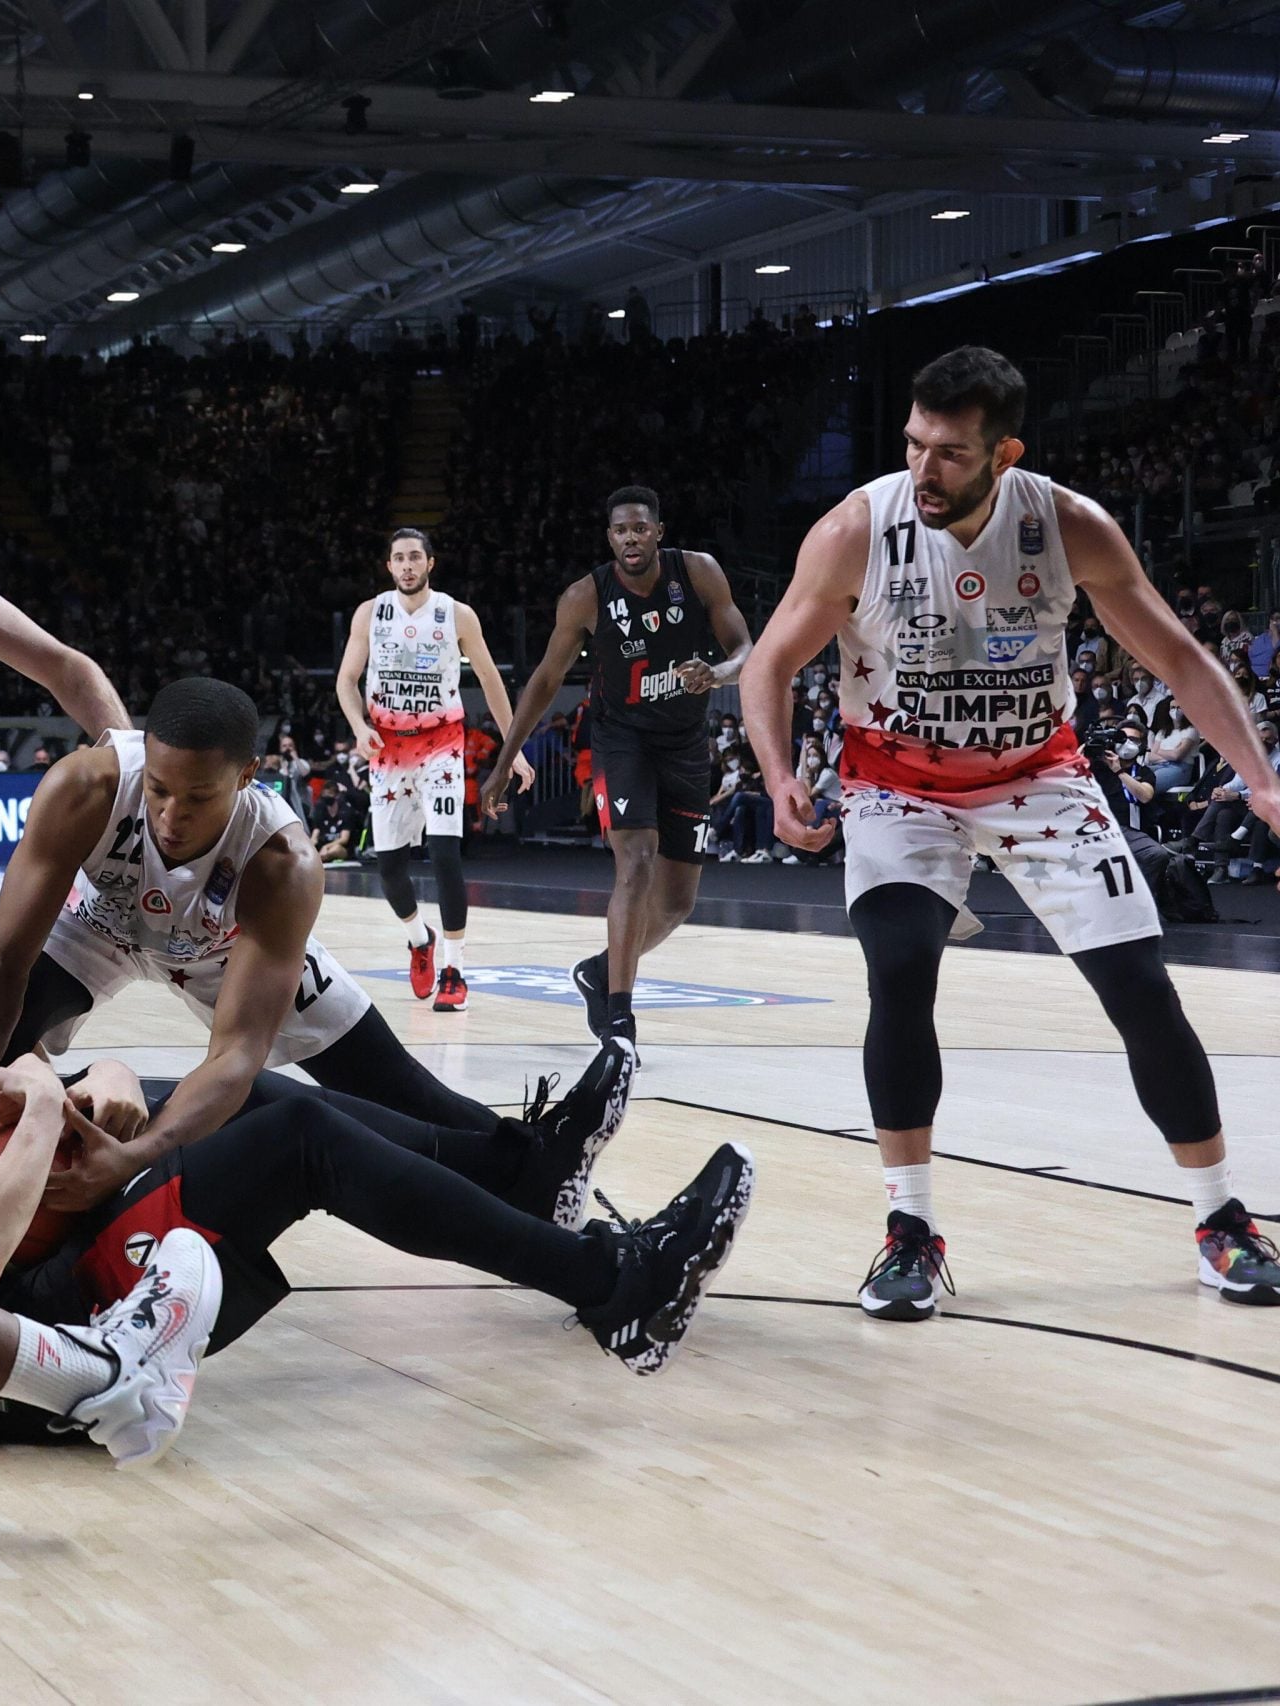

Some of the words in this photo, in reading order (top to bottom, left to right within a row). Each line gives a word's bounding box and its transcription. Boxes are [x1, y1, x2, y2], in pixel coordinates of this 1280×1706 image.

[883, 520, 916, 566] 17
[889, 577, 928, 598] EA7
[376, 604, 394, 621] 40
[607, 598, 629, 620] 14
[898, 627, 957, 640] OAKLEY
[989, 639, 1025, 658] SAP
[898, 673, 955, 689] ARMANI
[963, 668, 1052, 687] EXCHANGE
[898, 690, 1053, 722] OLIMPIA
[889, 714, 1054, 750] MILANO
[433, 796, 455, 815] 40
[1092, 854, 1134, 898] 17
